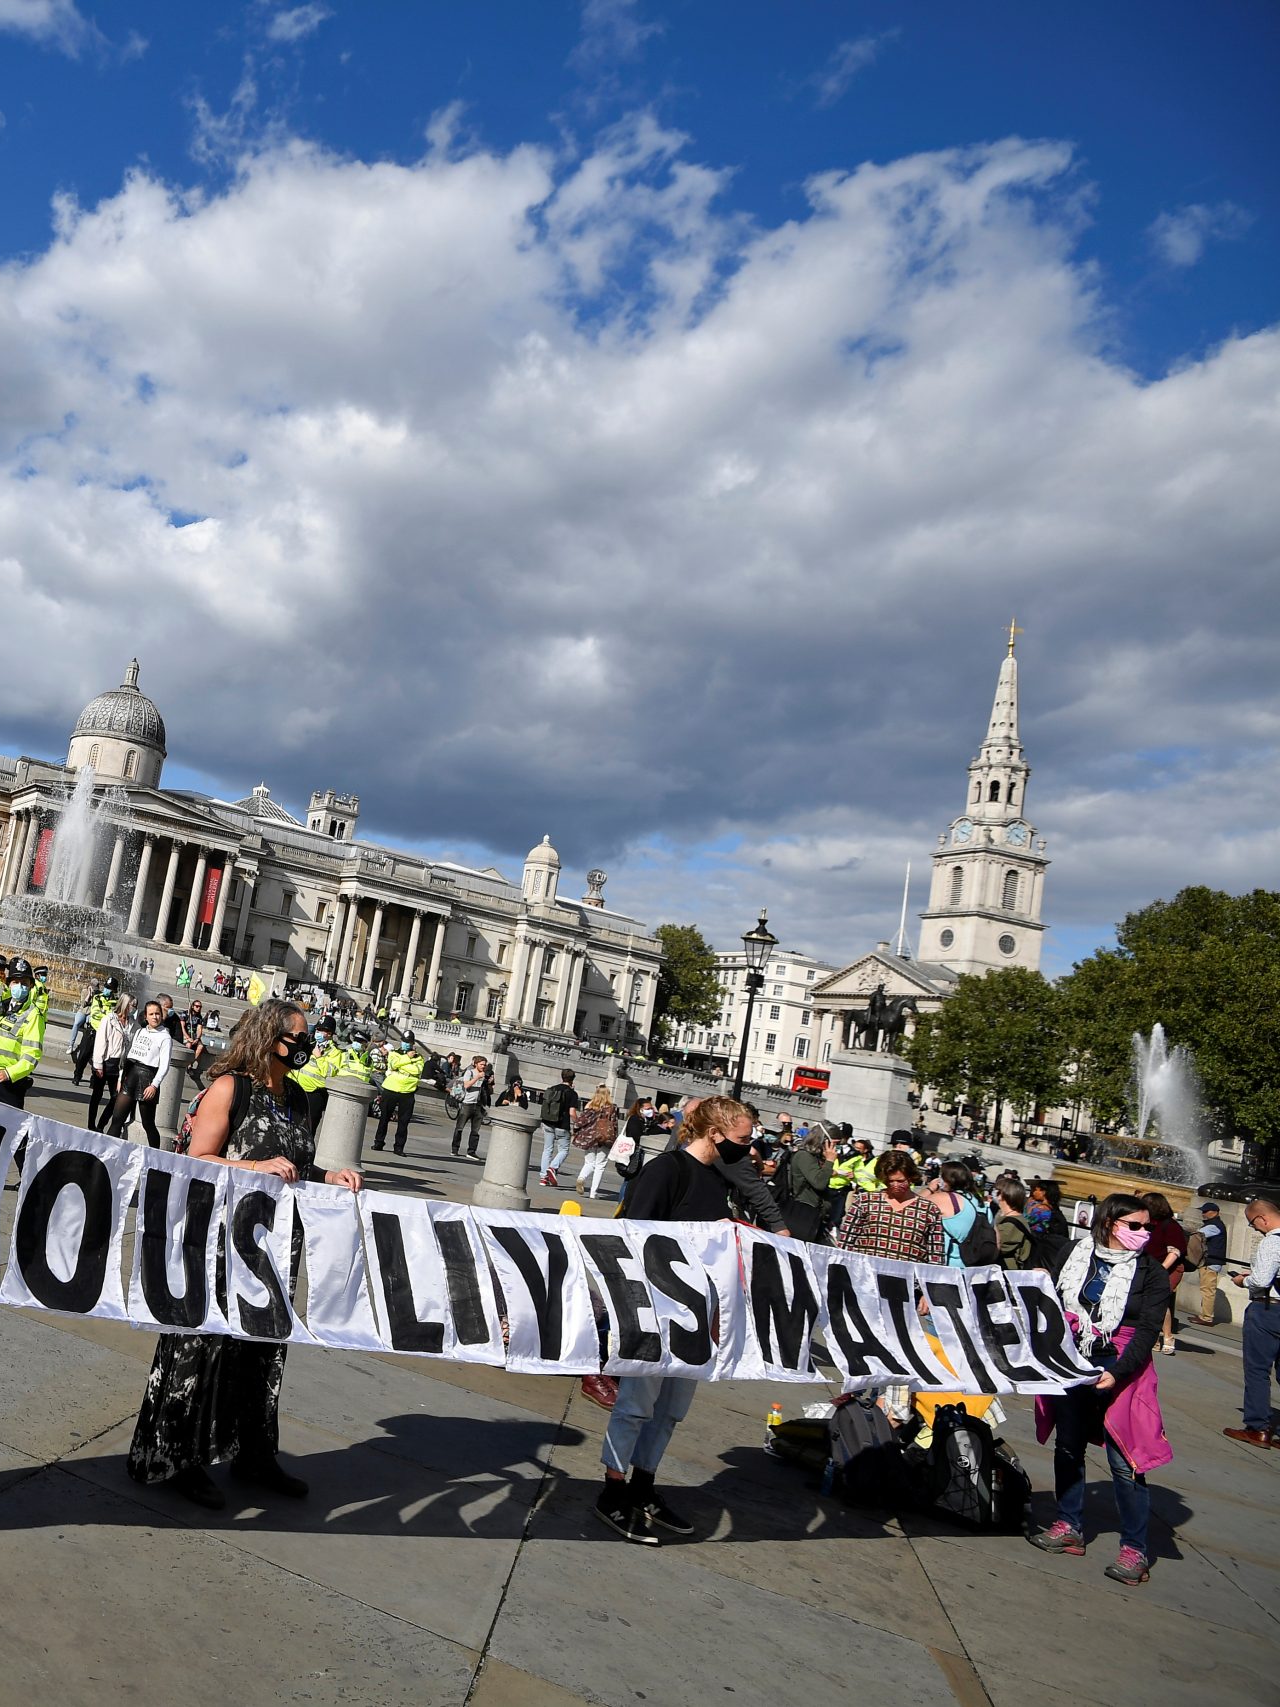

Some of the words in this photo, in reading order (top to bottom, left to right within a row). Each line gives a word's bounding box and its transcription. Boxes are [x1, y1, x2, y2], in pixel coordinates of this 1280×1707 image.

[210, 879, 219, 904] GALLERY
[373, 1212, 711, 1366] LIVES
[750, 1242, 1102, 1394] MATTER
